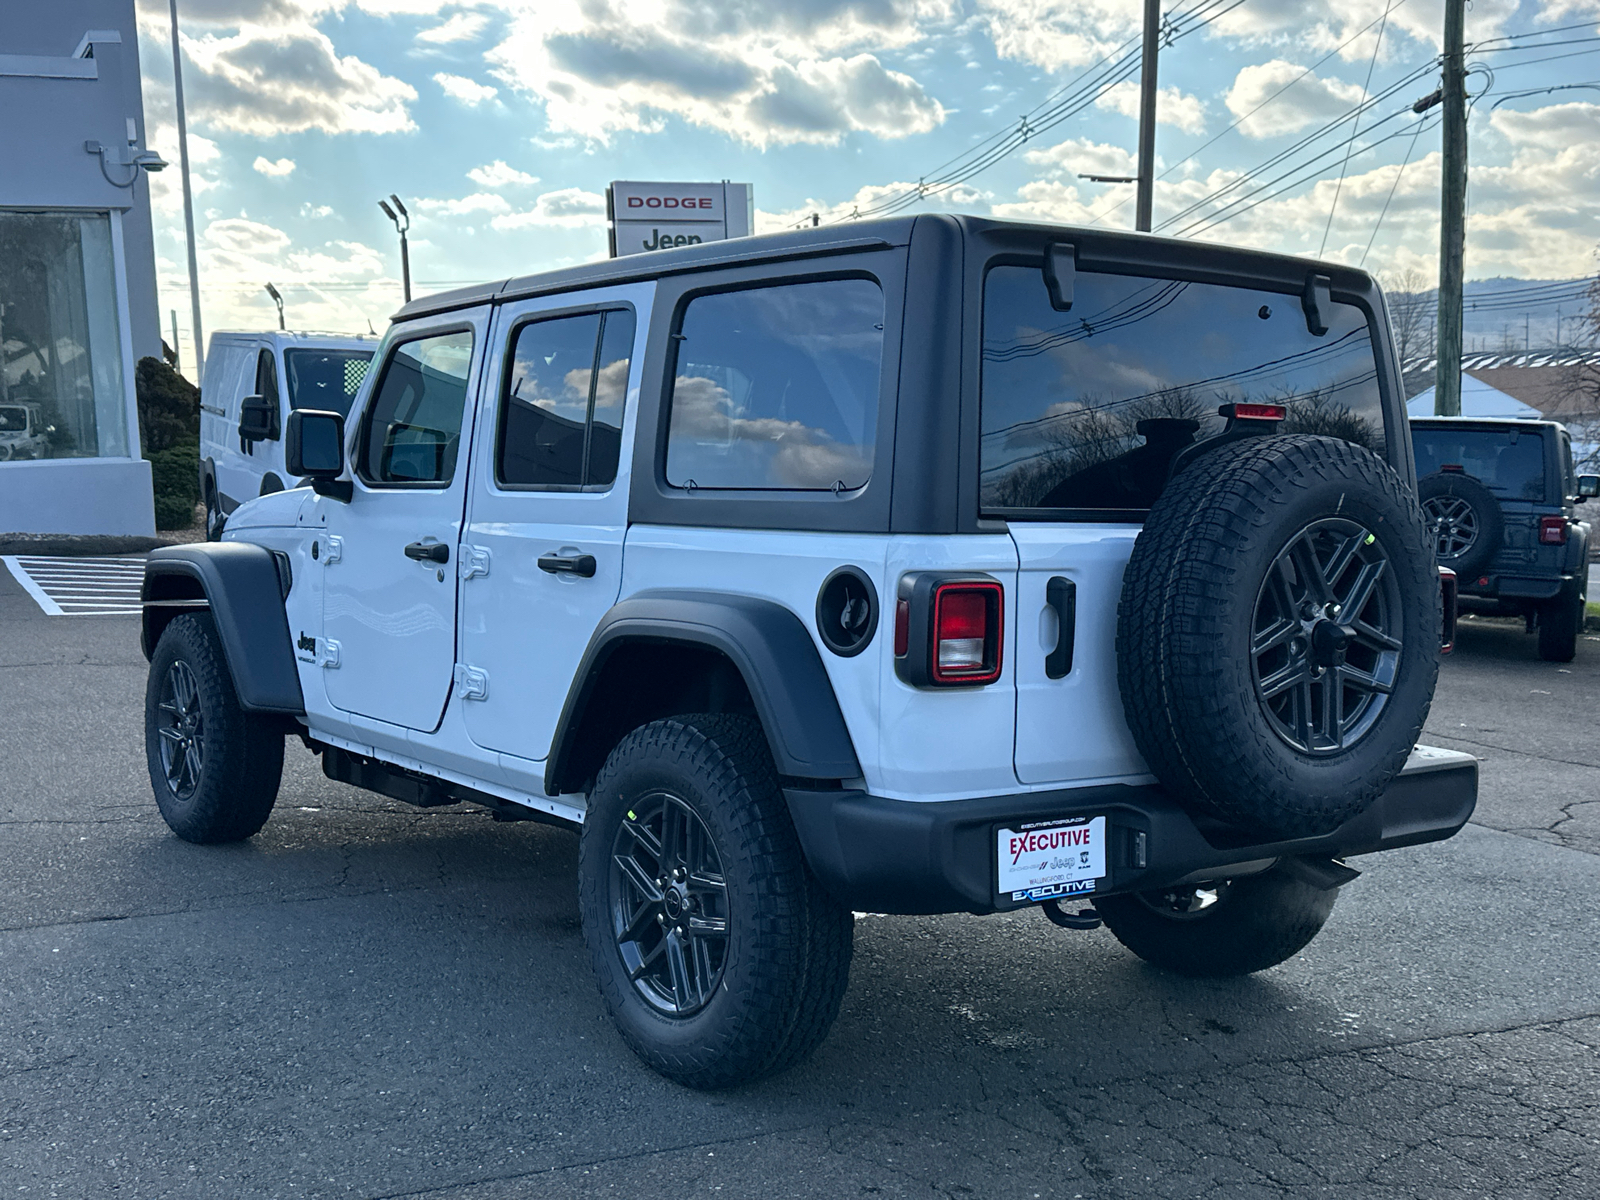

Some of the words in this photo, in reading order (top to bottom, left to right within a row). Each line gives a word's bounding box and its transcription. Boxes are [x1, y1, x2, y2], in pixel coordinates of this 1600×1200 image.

[627, 197, 713, 209] DODGE
[1010, 829, 1090, 865] EXECUTIVE
[1049, 857, 1075, 869] Jeep
[1012, 880, 1095, 901] EXECUTIVE
